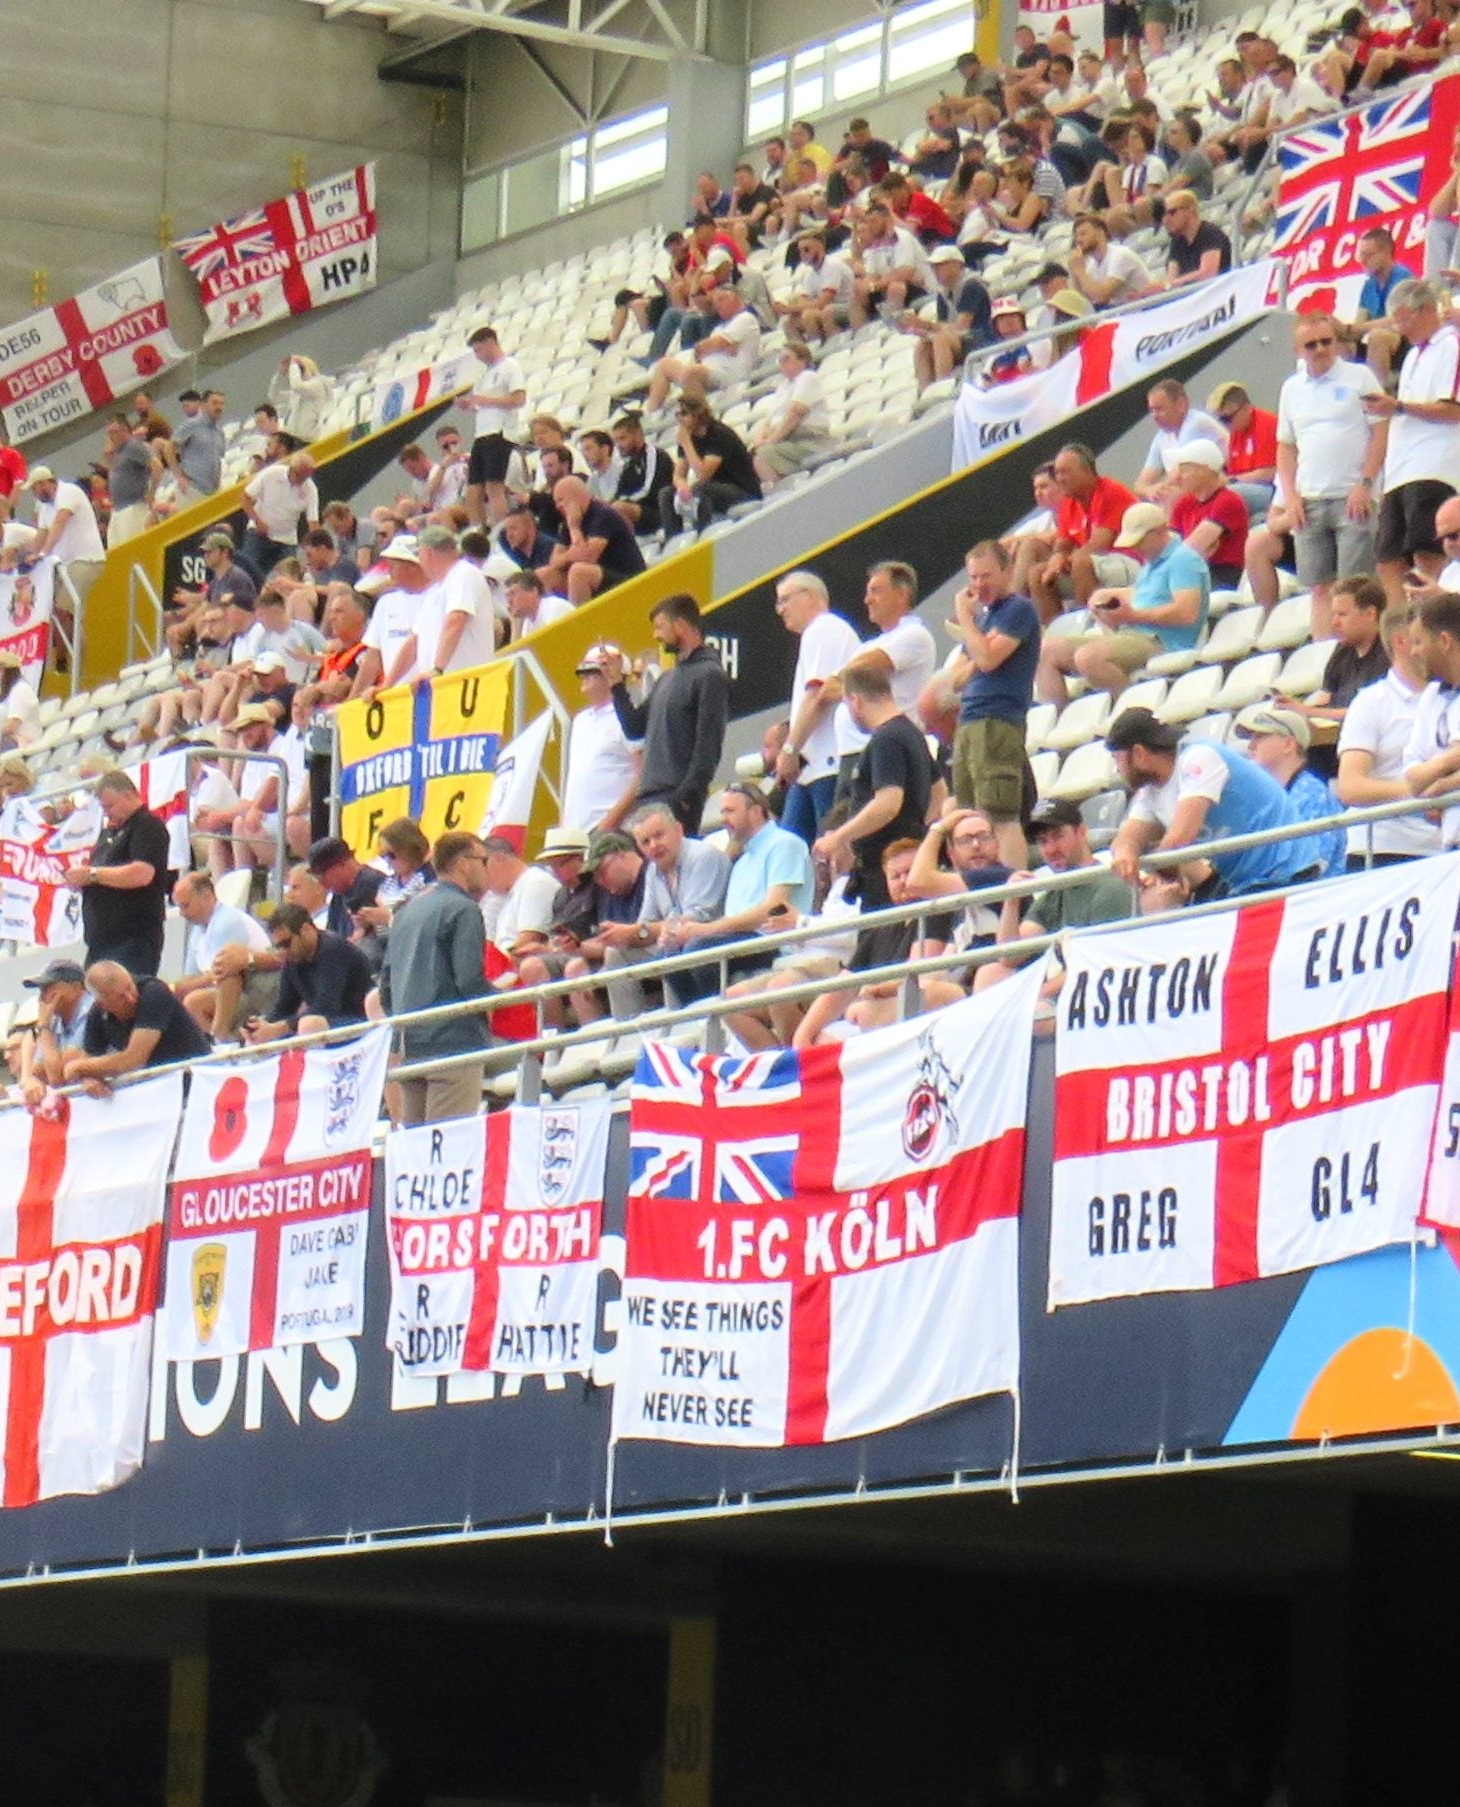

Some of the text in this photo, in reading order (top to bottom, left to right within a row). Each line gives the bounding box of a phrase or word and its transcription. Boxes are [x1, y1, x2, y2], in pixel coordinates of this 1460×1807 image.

[309, 179, 354, 203] UP THE
[209, 217, 368, 297] LEYTON ORIENT
[8, 309, 161, 397] DERBY COUNTY
[17, 398, 82, 437] ON TOUR
[366, 700, 384, 740] O
[460, 677, 480, 718] U
[355, 750, 413, 796] OXFORD
[448, 741, 458, 774] I
[460, 737, 488, 771] DIE
[368, 791, 466, 850] F C
[1068, 897, 1422, 1031] ASHTON ELLIS
[1106, 1021, 1392, 1143] BRISTOL CITY
[430, 1128, 444, 1164] R
[180, 1163, 365, 1228] GLOUCESTER CITY
[394, 1168, 474, 1212] CHLOE
[1088, 1142, 1382, 1257] GREG GL4
[290, 1229, 326, 1257] DAVE
[696, 1184, 940, 1280] 1.FC KÖLN
[416, 1274, 552, 1320] R R
[627, 1296, 784, 1333] WE SEE THINGS
[496, 1323, 582, 1366] HATTIE
[660, 1346, 739, 1382] THEY'LL
[642, 1391, 754, 1428] NEVER SEE
